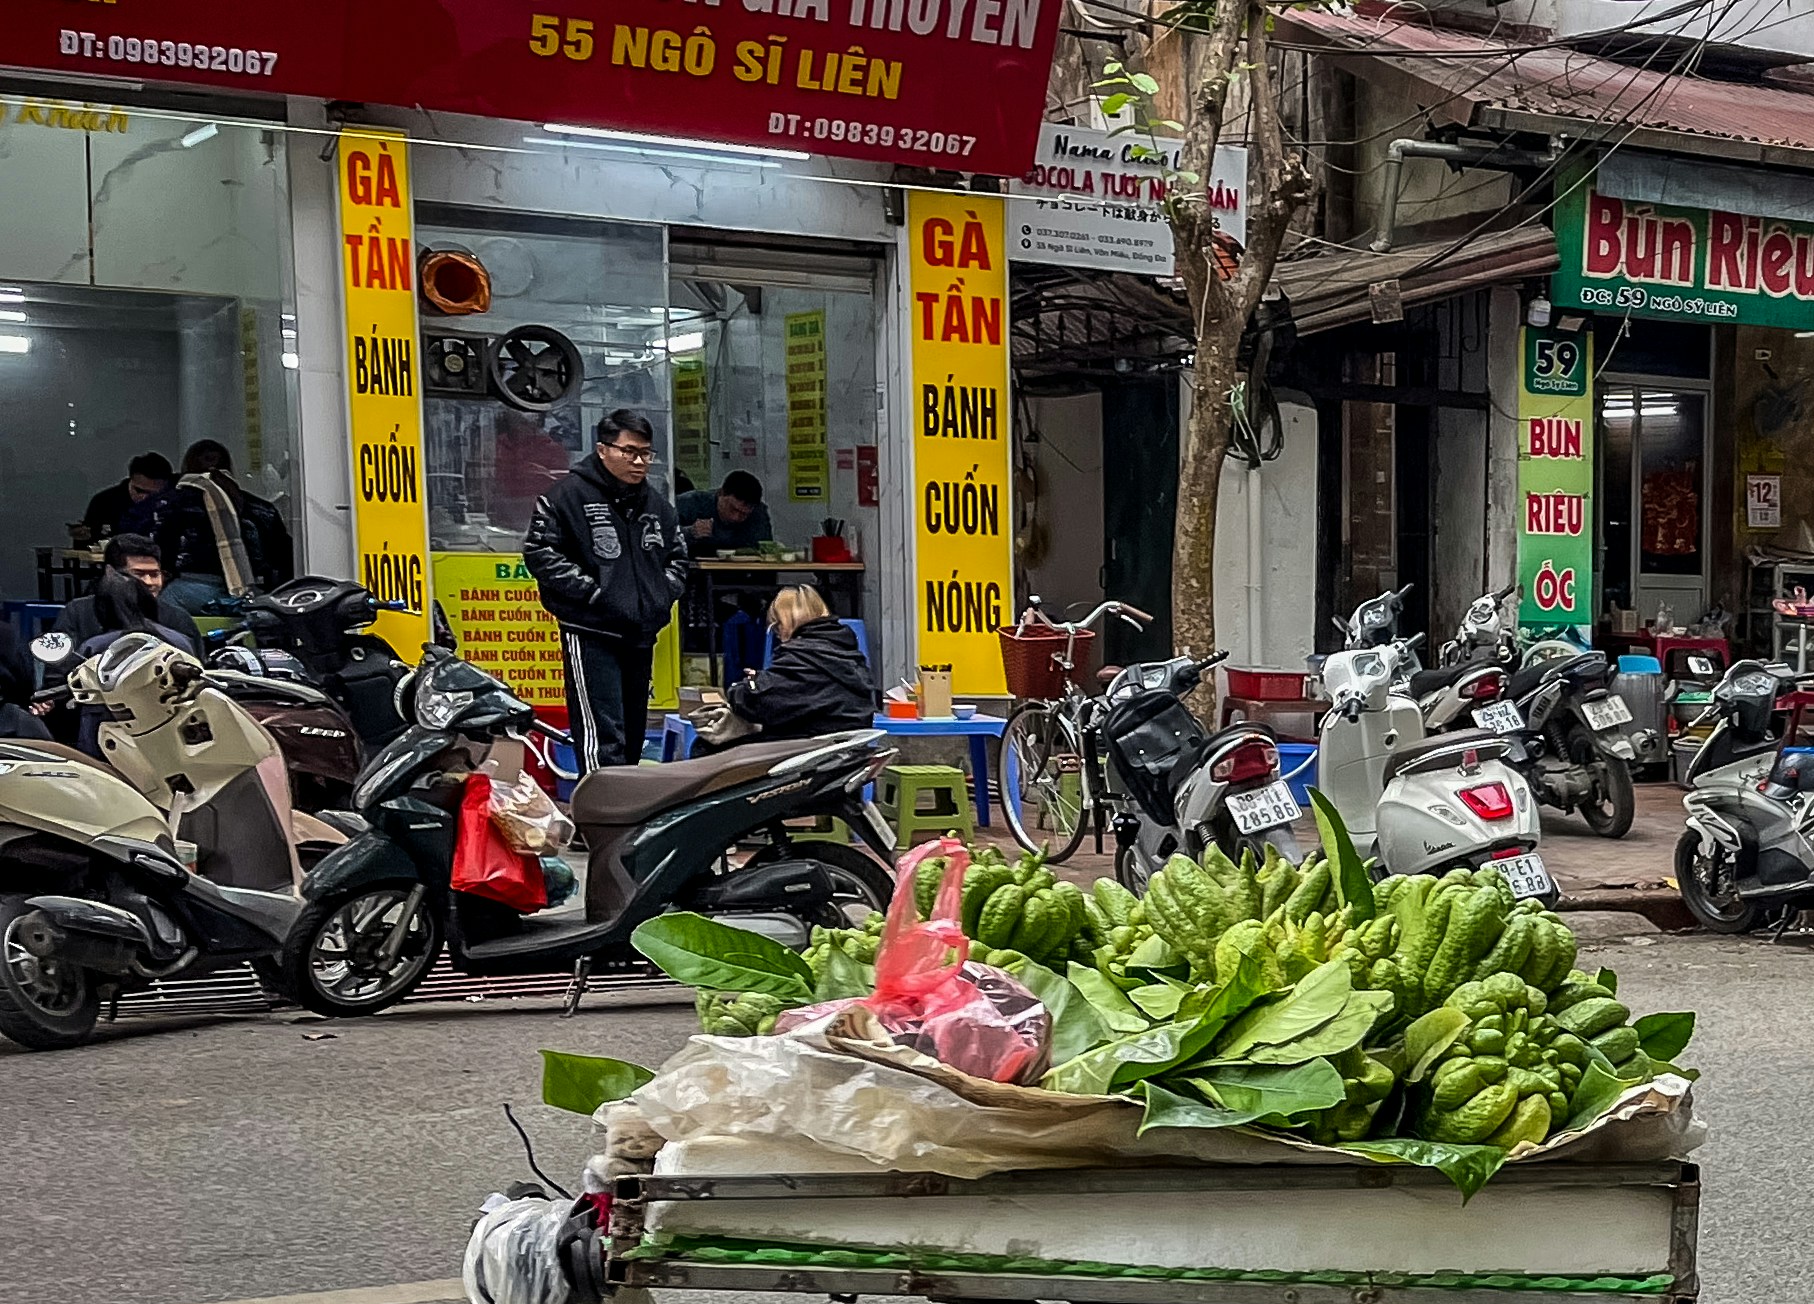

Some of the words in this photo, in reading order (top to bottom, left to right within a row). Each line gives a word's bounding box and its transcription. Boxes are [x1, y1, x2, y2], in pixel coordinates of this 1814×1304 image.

[529, 14, 594, 60] 55
[611, 25, 715, 75] NGÔ
[733, 35, 788, 84] SĨ
[797, 45, 903, 99] LIÊN
[346, 141, 401, 209] GÀ
[1055, 134, 1114, 162] Nama
[345, 217, 412, 291] TẦN
[922, 210, 991, 271] GÀ
[1582, 189, 1697, 288] Bún
[916, 277, 1001, 346] TẦN
[1616, 287, 1649, 308] 59
[1650, 296, 1683, 313] NGÔ
[1705, 299, 1738, 318] LIÊN
[354, 324, 412, 397] BÁNH
[1533, 340, 1580, 379] 59
[922, 374, 998, 441] BÁNH
[360, 424, 418, 503] CUỐN
[1754, 482, 1772, 503] 12
[925, 464, 999, 536] CUỐN
[1526, 488, 1584, 536] RIÊU
[364, 541, 422, 611] NÓNG
[460, 588, 500, 602] BÁNH
[926, 570, 1001, 634] NÓNG
[461, 607, 496, 622] BÁNH
[498, 605, 532, 622] CUỐN
[463, 627, 502, 643] BÁNH
[507, 626, 546, 643] CUỐN
[464, 647, 498, 662] BÁNH
[502, 645, 535, 662] CUỐN
[508, 663, 546, 680] CUỐN
[1239, 802, 1296, 831] 285.86
